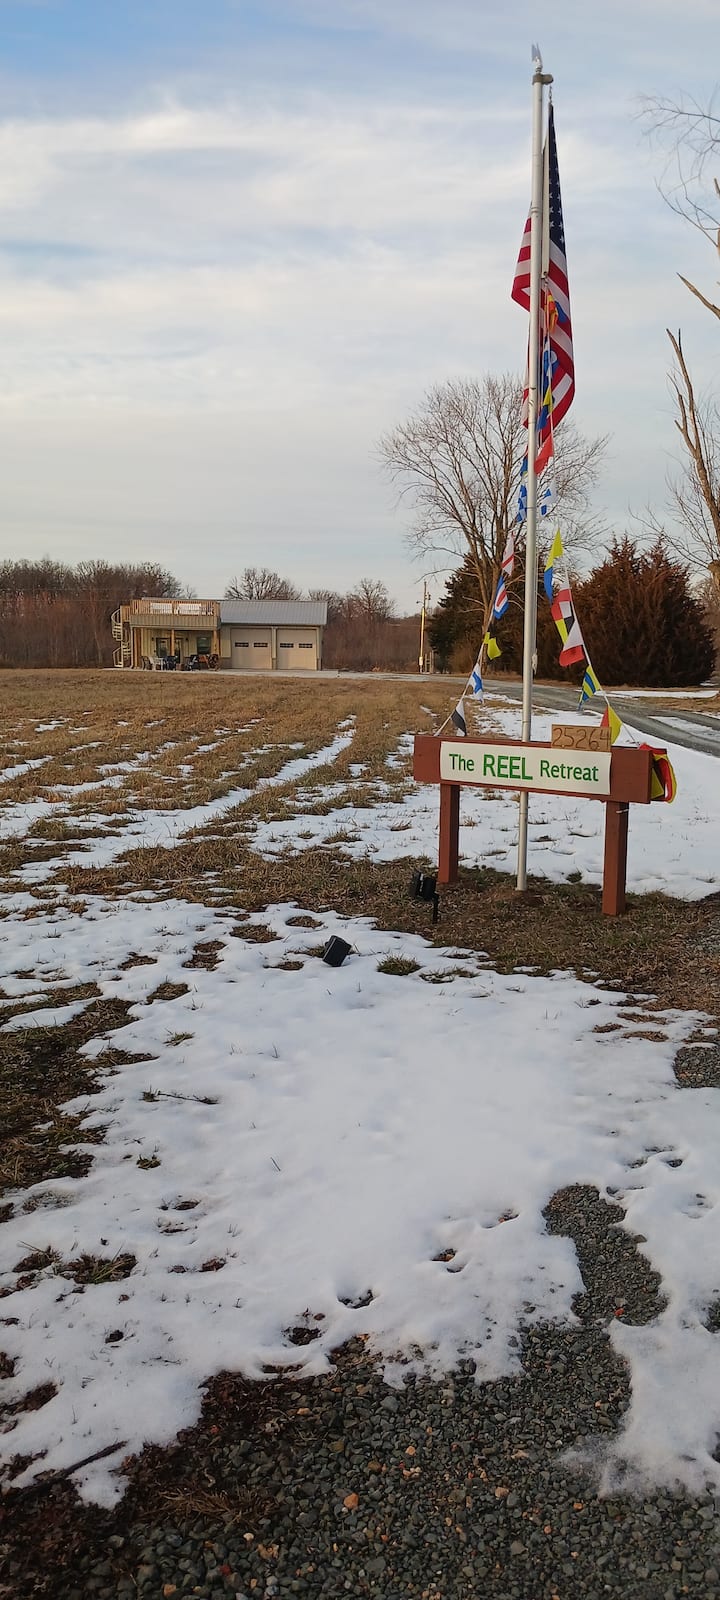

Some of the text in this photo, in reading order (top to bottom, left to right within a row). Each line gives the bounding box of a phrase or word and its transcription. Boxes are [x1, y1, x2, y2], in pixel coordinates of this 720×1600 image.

[552, 727, 611, 751] 25264
[449, 753, 599, 782] The REEL Retreat
